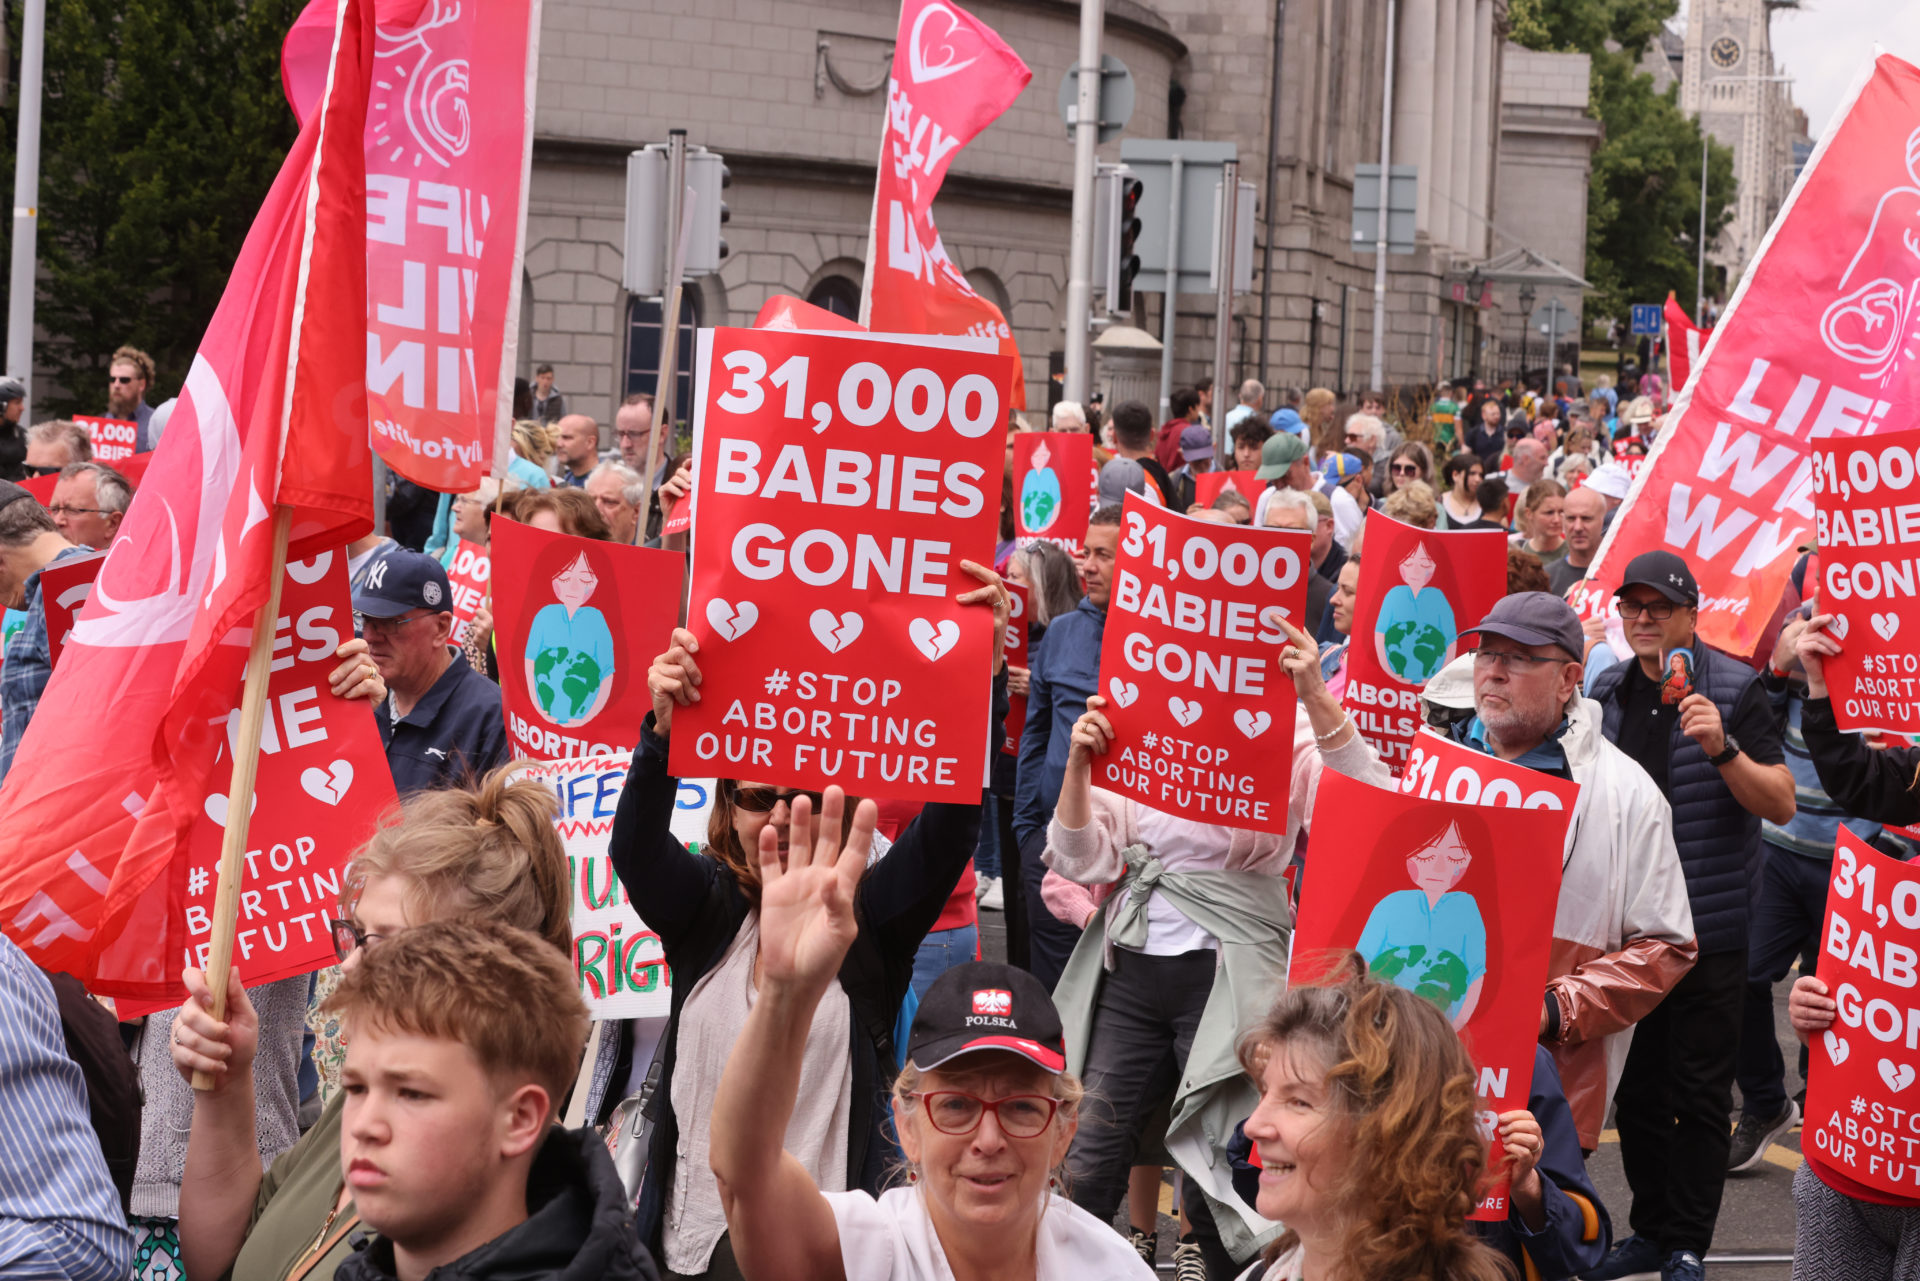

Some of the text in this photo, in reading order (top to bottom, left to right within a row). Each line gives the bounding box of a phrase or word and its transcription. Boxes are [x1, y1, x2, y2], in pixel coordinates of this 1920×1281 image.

[716, 350, 999, 438] 31,000
[715, 437, 986, 518] BABIES
[1812, 446, 1920, 502] 31,00
[1121, 511, 1301, 590] 31,000
[1816, 503, 1920, 548] BABIE
[731, 523, 951, 597] GONE
[1826, 558, 1920, 600] GON
[1115, 569, 1292, 645] BABIES
[764, 668, 902, 707] #STOP
[1124, 632, 1267, 696] GONE
[1854, 675, 1920, 698] ABORT
[1862, 653, 1920, 674] #STO
[1345, 679, 1419, 712] ABOR
[1845, 698, 1920, 721] OUR FUT
[721, 699, 937, 747] ABORTING
[695, 732, 958, 786] OUR FUTURE
[1120, 746, 1255, 795] ABORTING
[1142, 731, 1229, 767] #STOP
[1106, 763, 1271, 821] OUR FUTURE
[188, 836, 316, 897] #TOP
[1833, 846, 1920, 929] 31,0
[1827, 910, 1918, 989] BAB
[965, 1016, 1018, 1029] POLSKA
[1828, 1110, 1920, 1158] ABORT
[1850, 1094, 1920, 1133] #STO
[1816, 1128, 1920, 1186] OUR FUT
